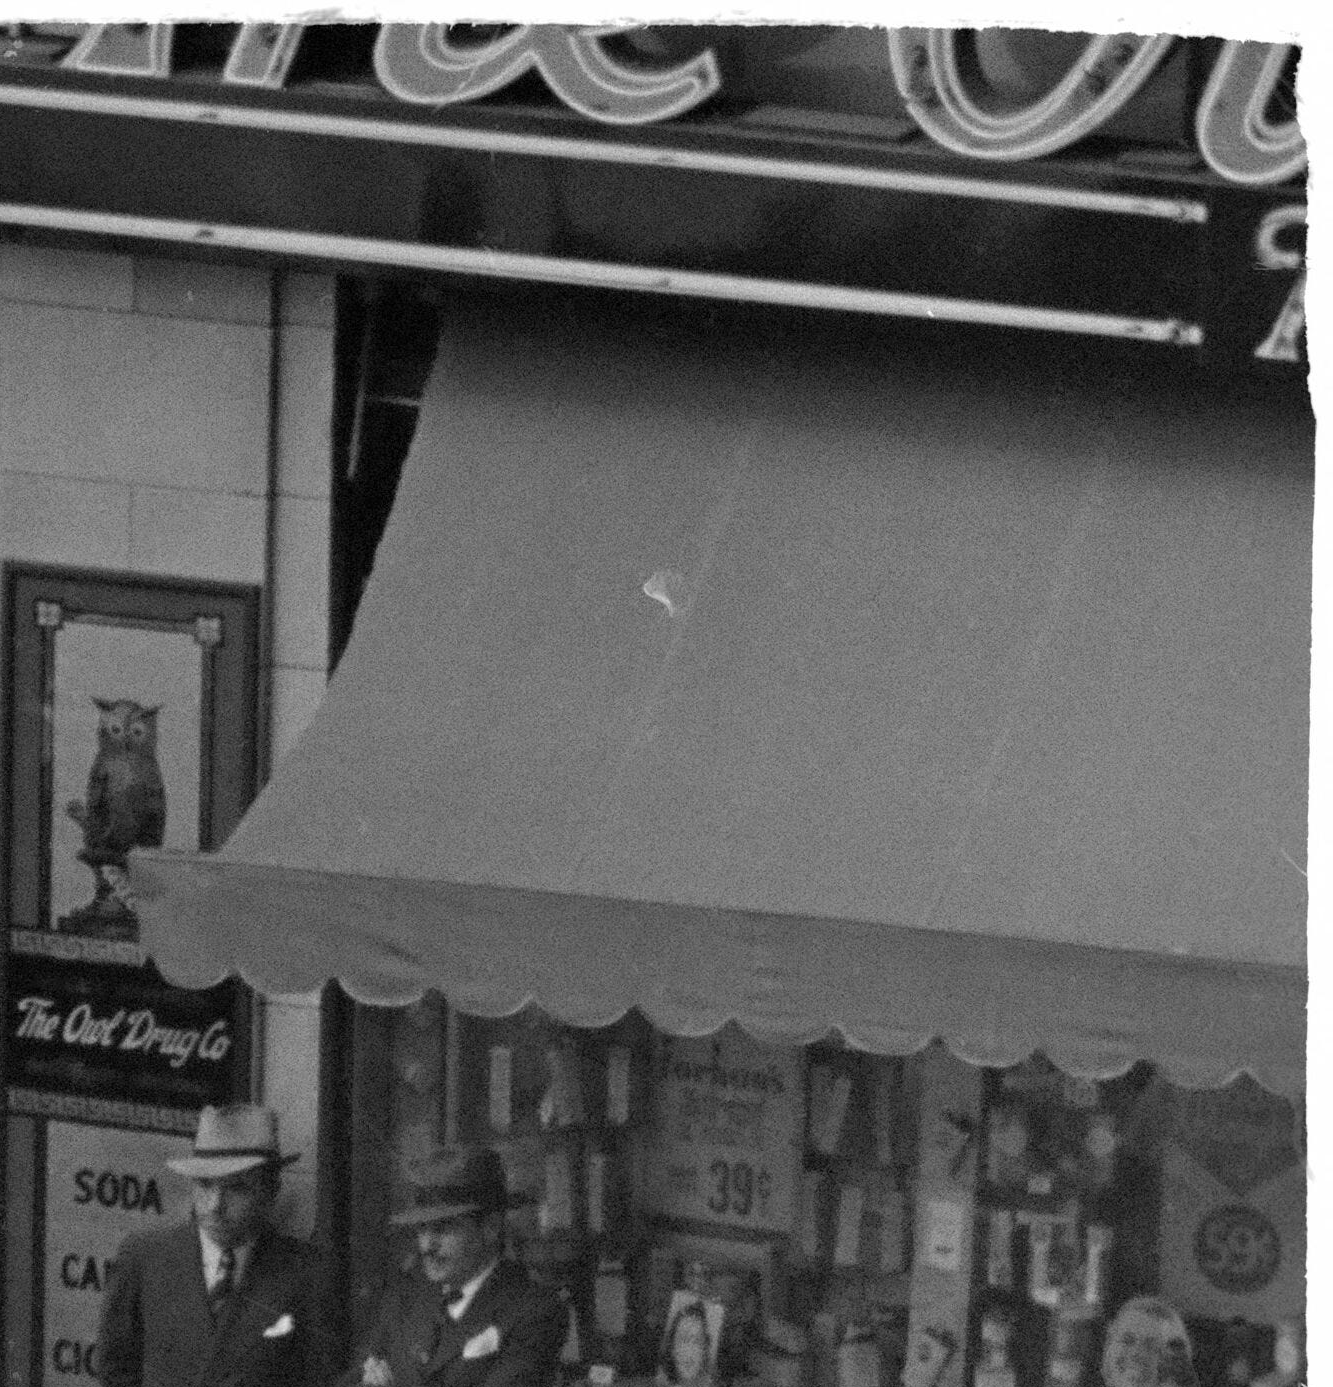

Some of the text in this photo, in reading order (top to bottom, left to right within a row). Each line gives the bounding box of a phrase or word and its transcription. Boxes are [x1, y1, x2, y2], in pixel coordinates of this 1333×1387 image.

[15, 996, 230, 1068] The Owl Drug Co
[73, 1167, 164, 1215] SODA
